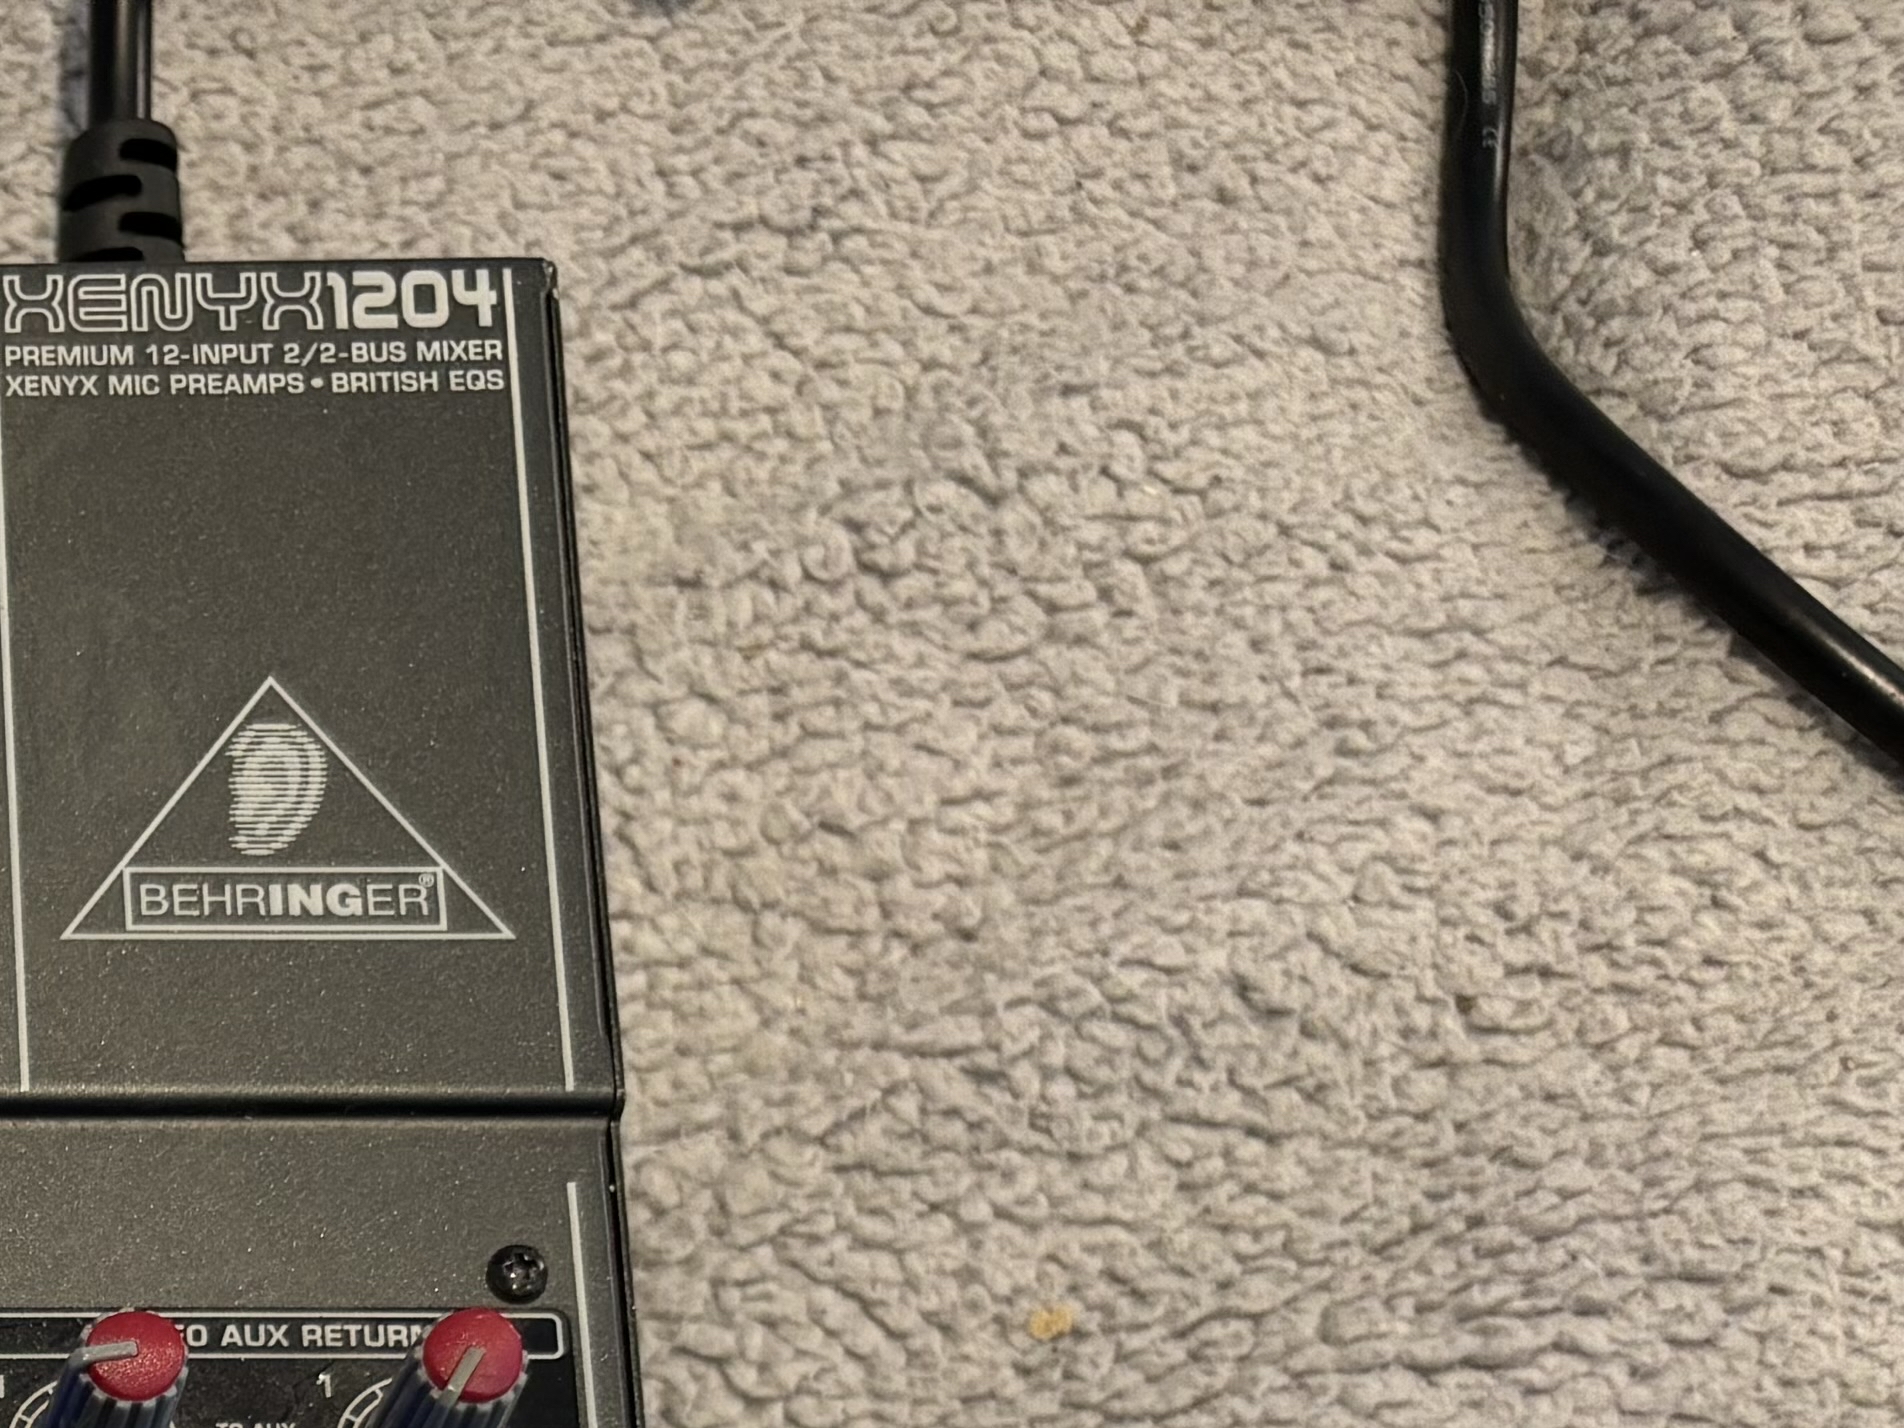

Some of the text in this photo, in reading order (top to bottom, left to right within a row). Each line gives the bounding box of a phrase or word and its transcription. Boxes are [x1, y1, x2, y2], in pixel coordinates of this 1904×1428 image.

[5, 340, 503, 367] PREMIUM 12-INPUT 2/2-BUS MIXER
[5, 370, 504, 397] XENYX MIC PREAMPS BRITISH EQS
[140, 883, 429, 917] BEHRINGER
[220, 1322, 429, 1349] AUX RETURN
